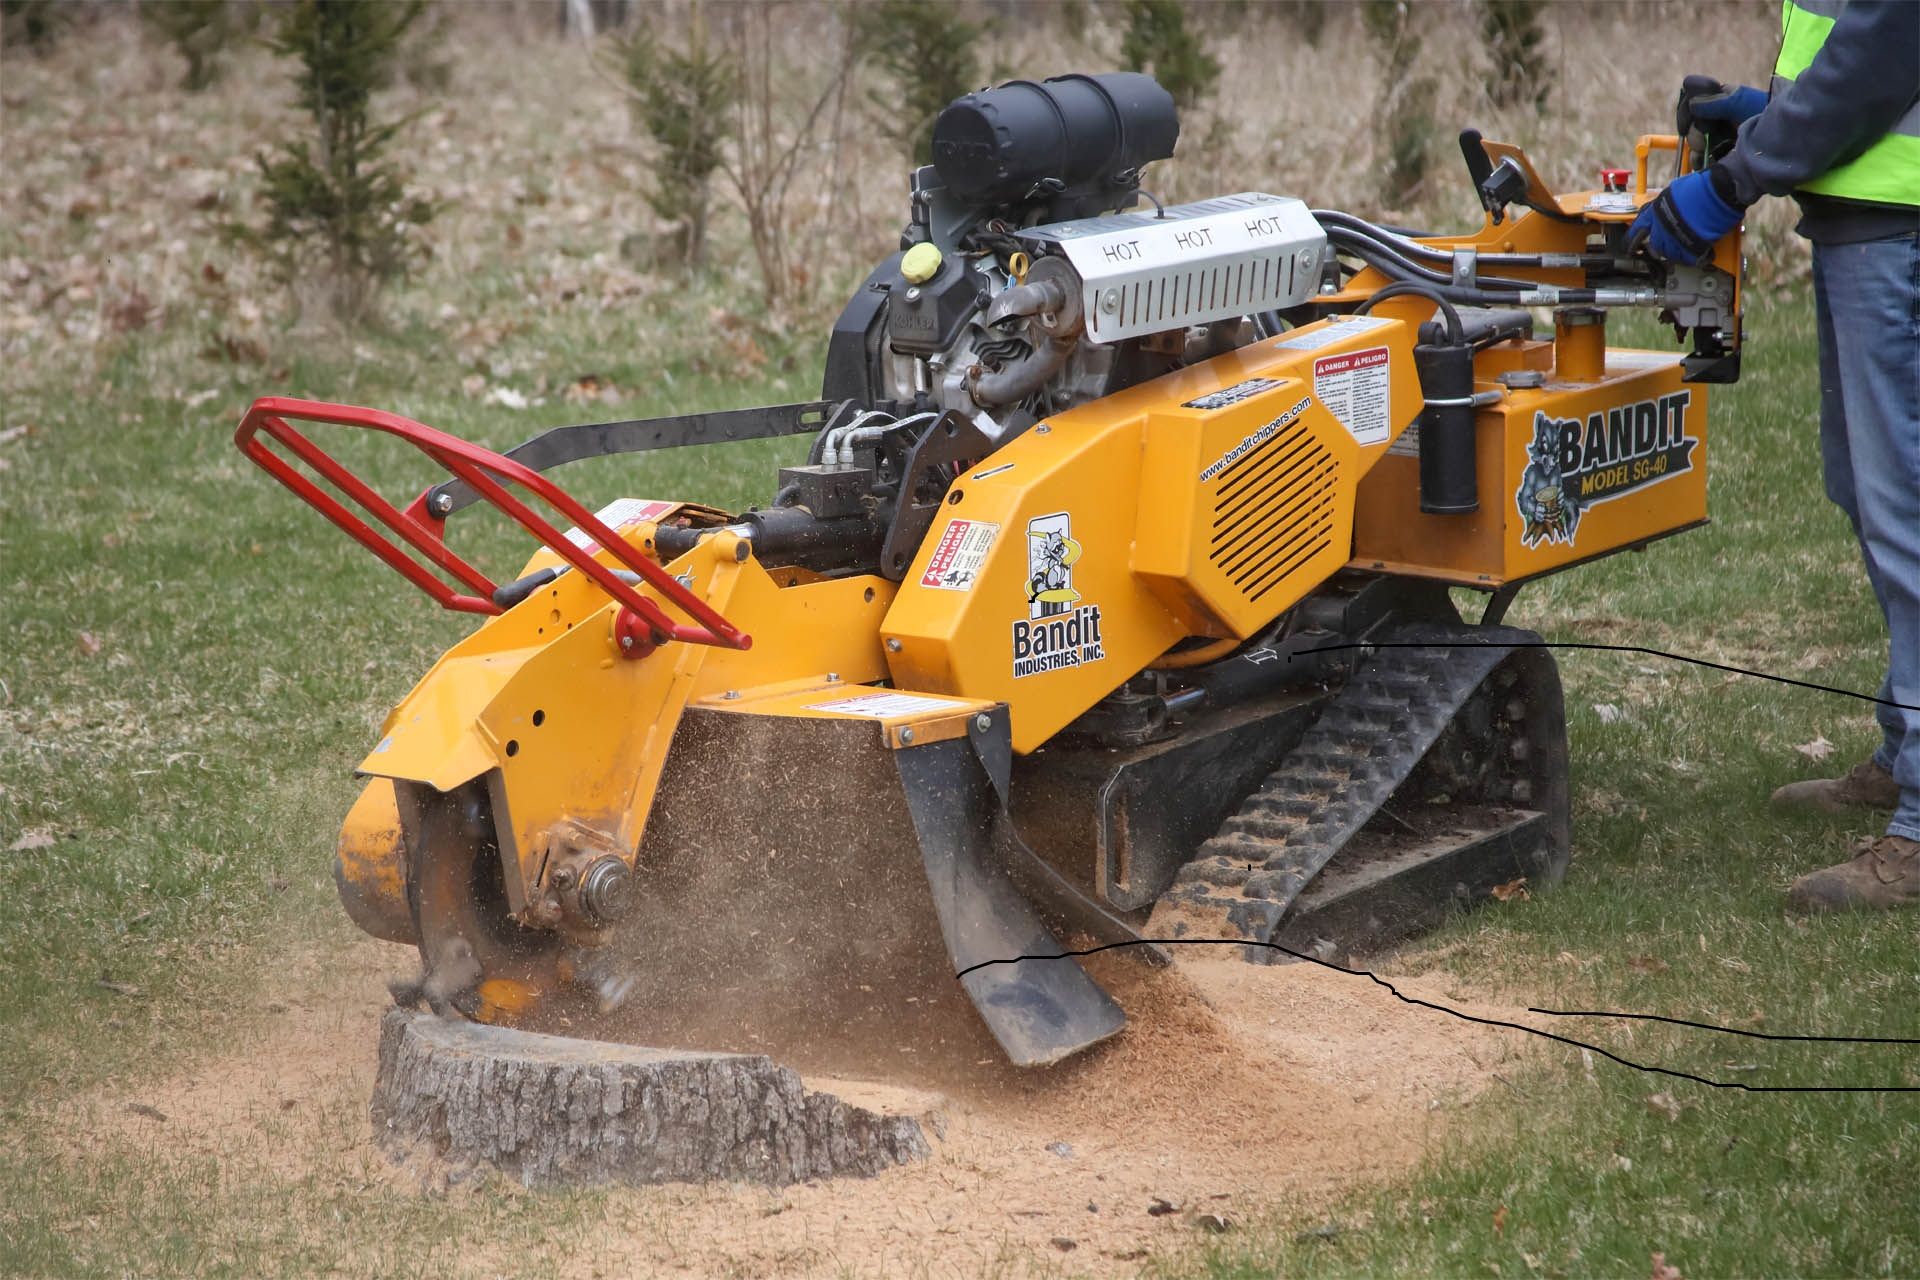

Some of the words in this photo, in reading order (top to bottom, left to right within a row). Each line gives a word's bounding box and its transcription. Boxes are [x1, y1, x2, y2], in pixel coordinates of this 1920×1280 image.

[1102, 241, 1142, 263] HOT
[1174, 228, 1214, 250] HOT
[1244, 216, 1283, 238] HOT
[1325, 360, 1350, 371] DANGER
[1361, 353, 1387, 365] PELIGRO
[1200, 397, 1311, 481] www.banditchippers.com
[1559, 391, 1690, 474] BANDIT
[1582, 467, 1629, 495] MODEL
[1633, 454, 1667, 481] SG-40
[931, 525, 957, 568] DANGER
[941, 524, 967, 569] PELIGRO
[1014, 606, 1100, 659] Bandit
[1015, 650, 1080, 677] INDUSTRIES,
[1083, 644, 1104, 662] INC.
